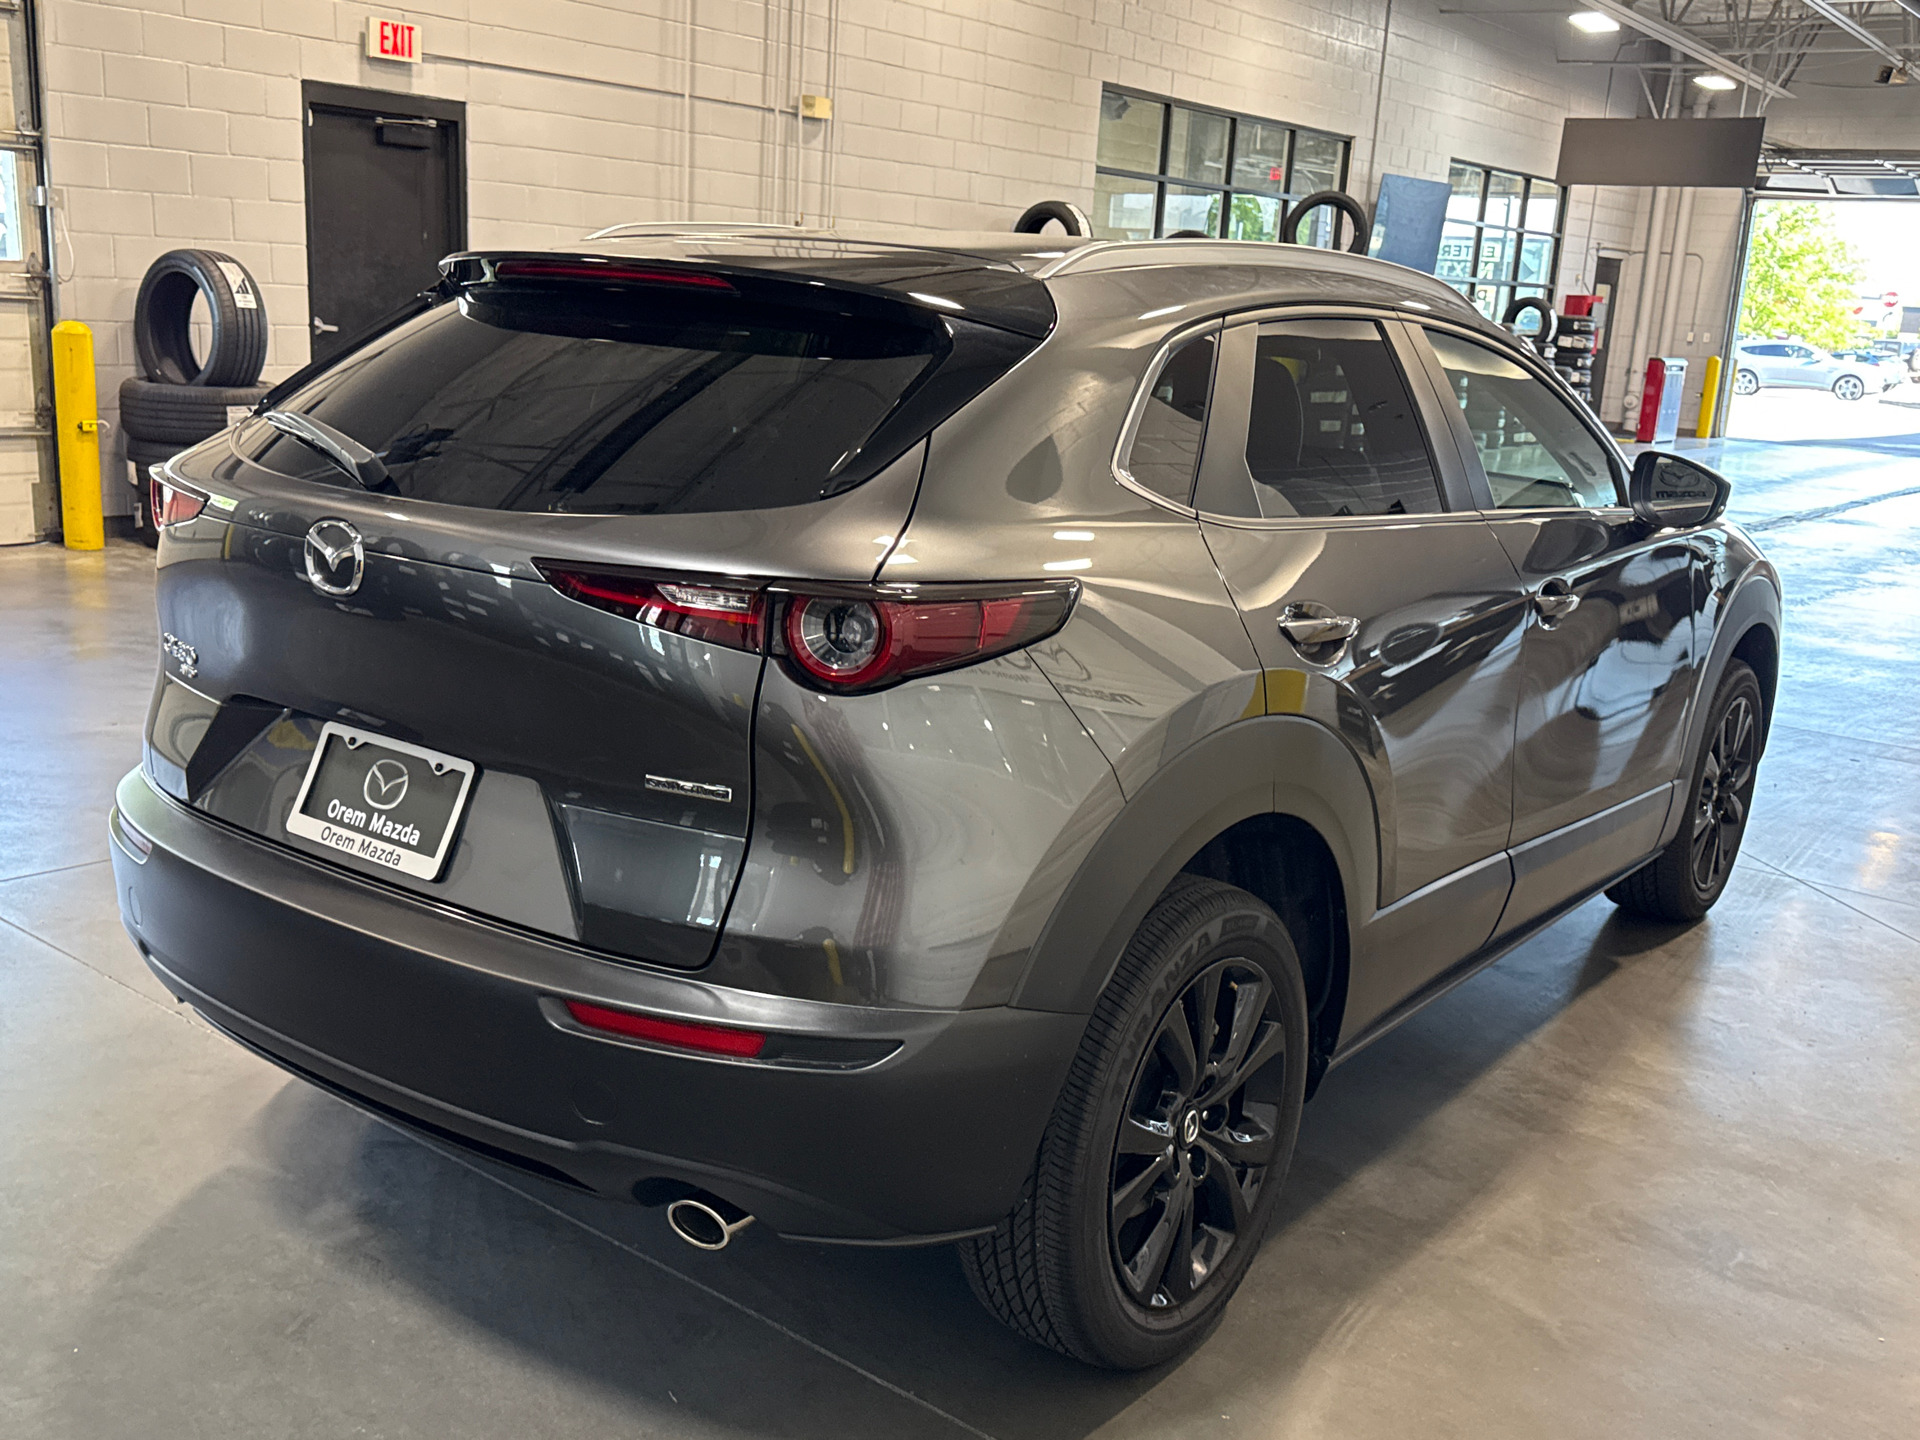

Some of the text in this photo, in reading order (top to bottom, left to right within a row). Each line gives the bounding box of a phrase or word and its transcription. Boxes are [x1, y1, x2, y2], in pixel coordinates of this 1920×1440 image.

[379, 20, 415, 58] EXIT
[327, 798, 421, 846] Orem Mazda
[320, 826, 402, 867] Orem Mazda
